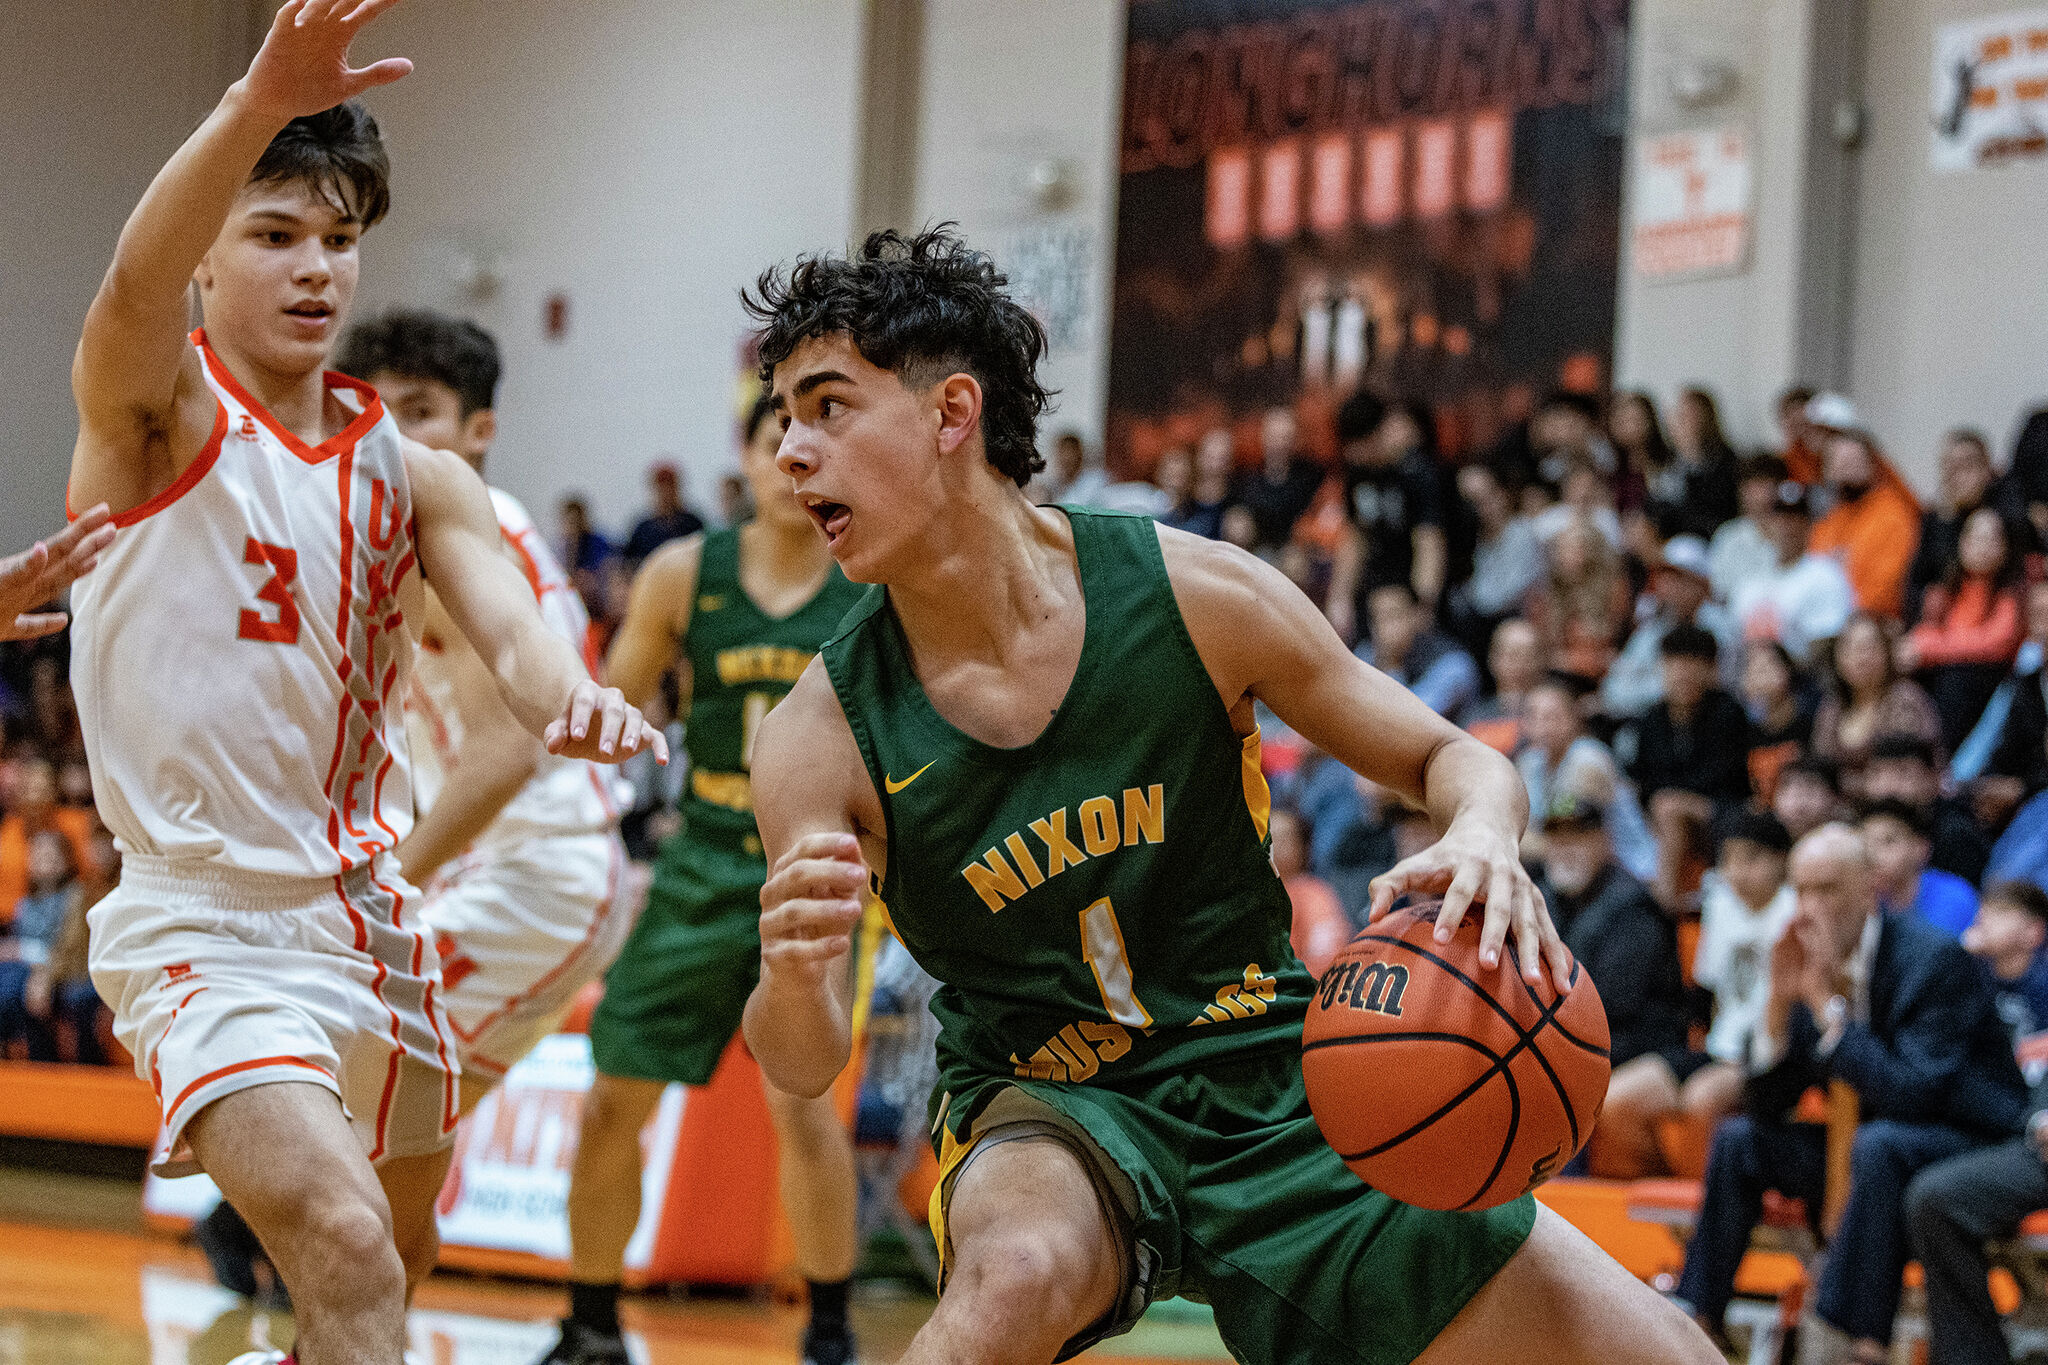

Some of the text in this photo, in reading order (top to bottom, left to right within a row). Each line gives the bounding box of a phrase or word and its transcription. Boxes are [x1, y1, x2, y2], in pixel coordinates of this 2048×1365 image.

[237, 536, 299, 645] 3
[961, 783, 1165, 914] NIXON
[1078, 895, 1154, 1029] 1
